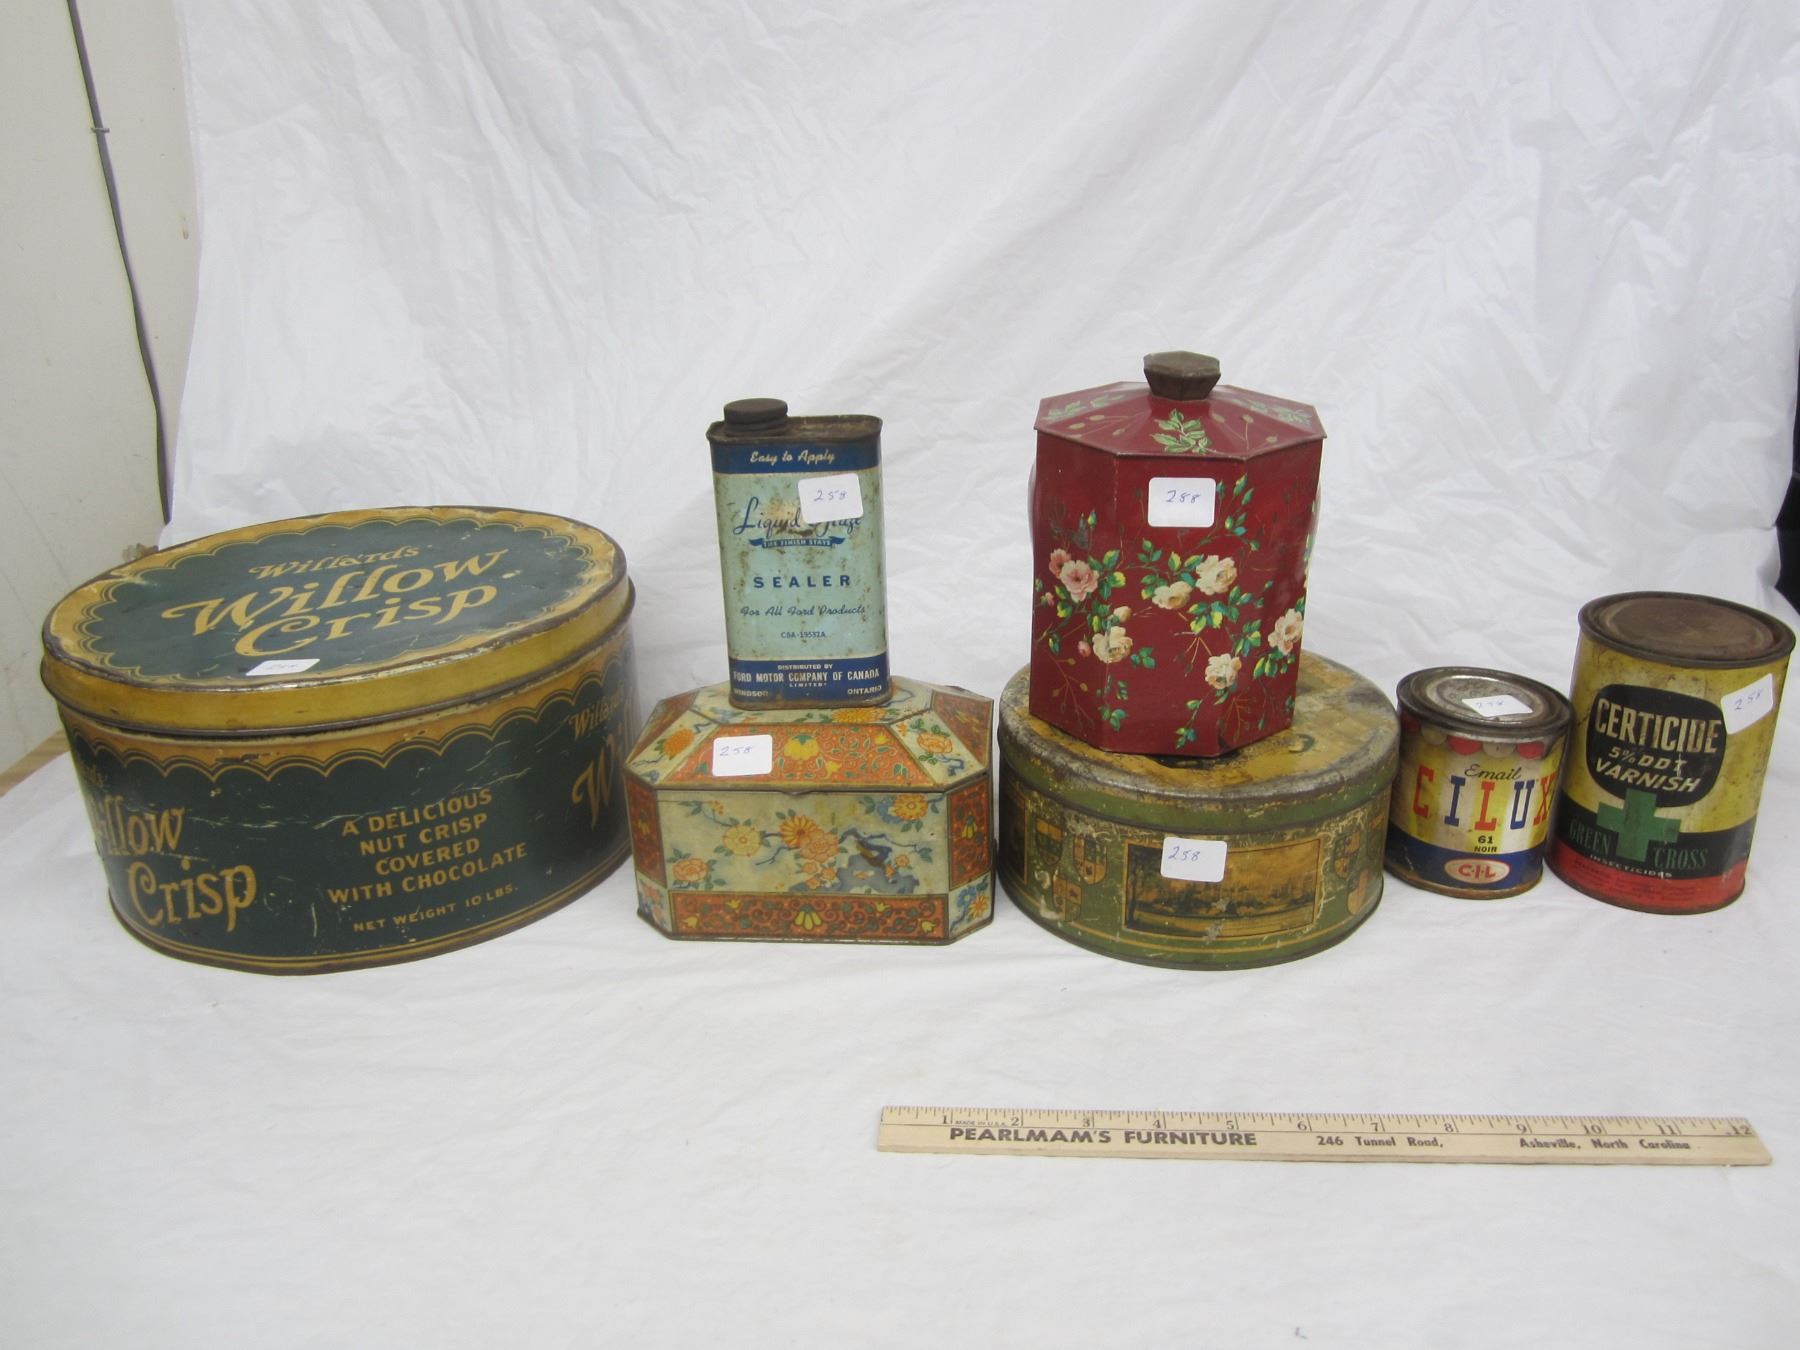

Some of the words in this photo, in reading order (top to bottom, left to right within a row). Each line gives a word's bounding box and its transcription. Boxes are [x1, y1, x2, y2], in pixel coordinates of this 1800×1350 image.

[750, 450, 778, 466] Easy
[782, 450, 793, 462] to
[798, 449, 835, 465] Apply
[733, 497, 801, 539] Liquid
[248, 545, 419, 580] Willards
[161, 549, 509, 636] Willow
[753, 575, 851, 589] SEALER
[235, 585, 498, 657] Crisp
[740, 606, 760, 616] For
[765, 606, 782, 616] All
[787, 606, 814, 616] Ford
[818, 604, 865, 616] Products
[733, 671, 752, 682] FORD
[756, 671, 784, 682] MOTOR
[788, 671, 828, 682] COMPANY
[833, 671, 843, 681] OF
[847, 668, 880, 681] CANADA
[847, 685, 882, 695] ONTARIO
[1595, 698, 1722, 754] CERTICIDE
[1464, 763, 1522, 781] Email
[1595, 757, 1701, 793] VARNISH
[1608, 746, 1635, 764] 5%
[1637, 754, 1688, 773] DDT
[341, 820, 360, 837] A
[368, 788, 493, 833] DELICIOUS
[1413, 764, 1557, 832] CILUX
[360, 834, 407, 855] NUT
[419, 813, 488, 844] CRISP
[1477, 835, 1494, 844] 61
[1569, 819, 1611, 856] GREEN
[1654, 847, 1709, 870] CROSS
[375, 838, 481, 875] COVERED
[1168, 845, 1201, 861] 258
[327, 882, 393, 904] WITH
[402, 842, 528, 893] CHOCOLATE
[128, 856, 257, 932] Crisp
[353, 918, 385, 932] NET
[392, 902, 457, 925] WEIGHT
[466, 896, 482, 908] 10
[950, 1127, 1112, 1144] PEARLMAM'S
[1124, 1130, 1257, 1146] FURNITURE
[1316, 1135, 1344, 1146] 246
[1355, 1135, 1397, 1147] Tunnel
[1591, 1138, 1628, 1149] North
[1639, 1138, 1691, 1150] Carolina
[1010, 1116, 1020, 1127] 2
[1082, 1117, 1091, 1128] 3
[1152, 1119, 1162, 1129] 4
[1226, 1120, 1235, 1130] 5
[1296, 1120, 1307, 1131] 6
[1370, 1122, 1379, 1132] 7
[1444, 1122, 1454, 1133] 8
[1516, 1123, 1527, 1134] 9
[1583, 1124, 1602, 1135] 10
[1658, 1124, 1675, 1135] 11
[1731, 1124, 1752, 1136] 12
